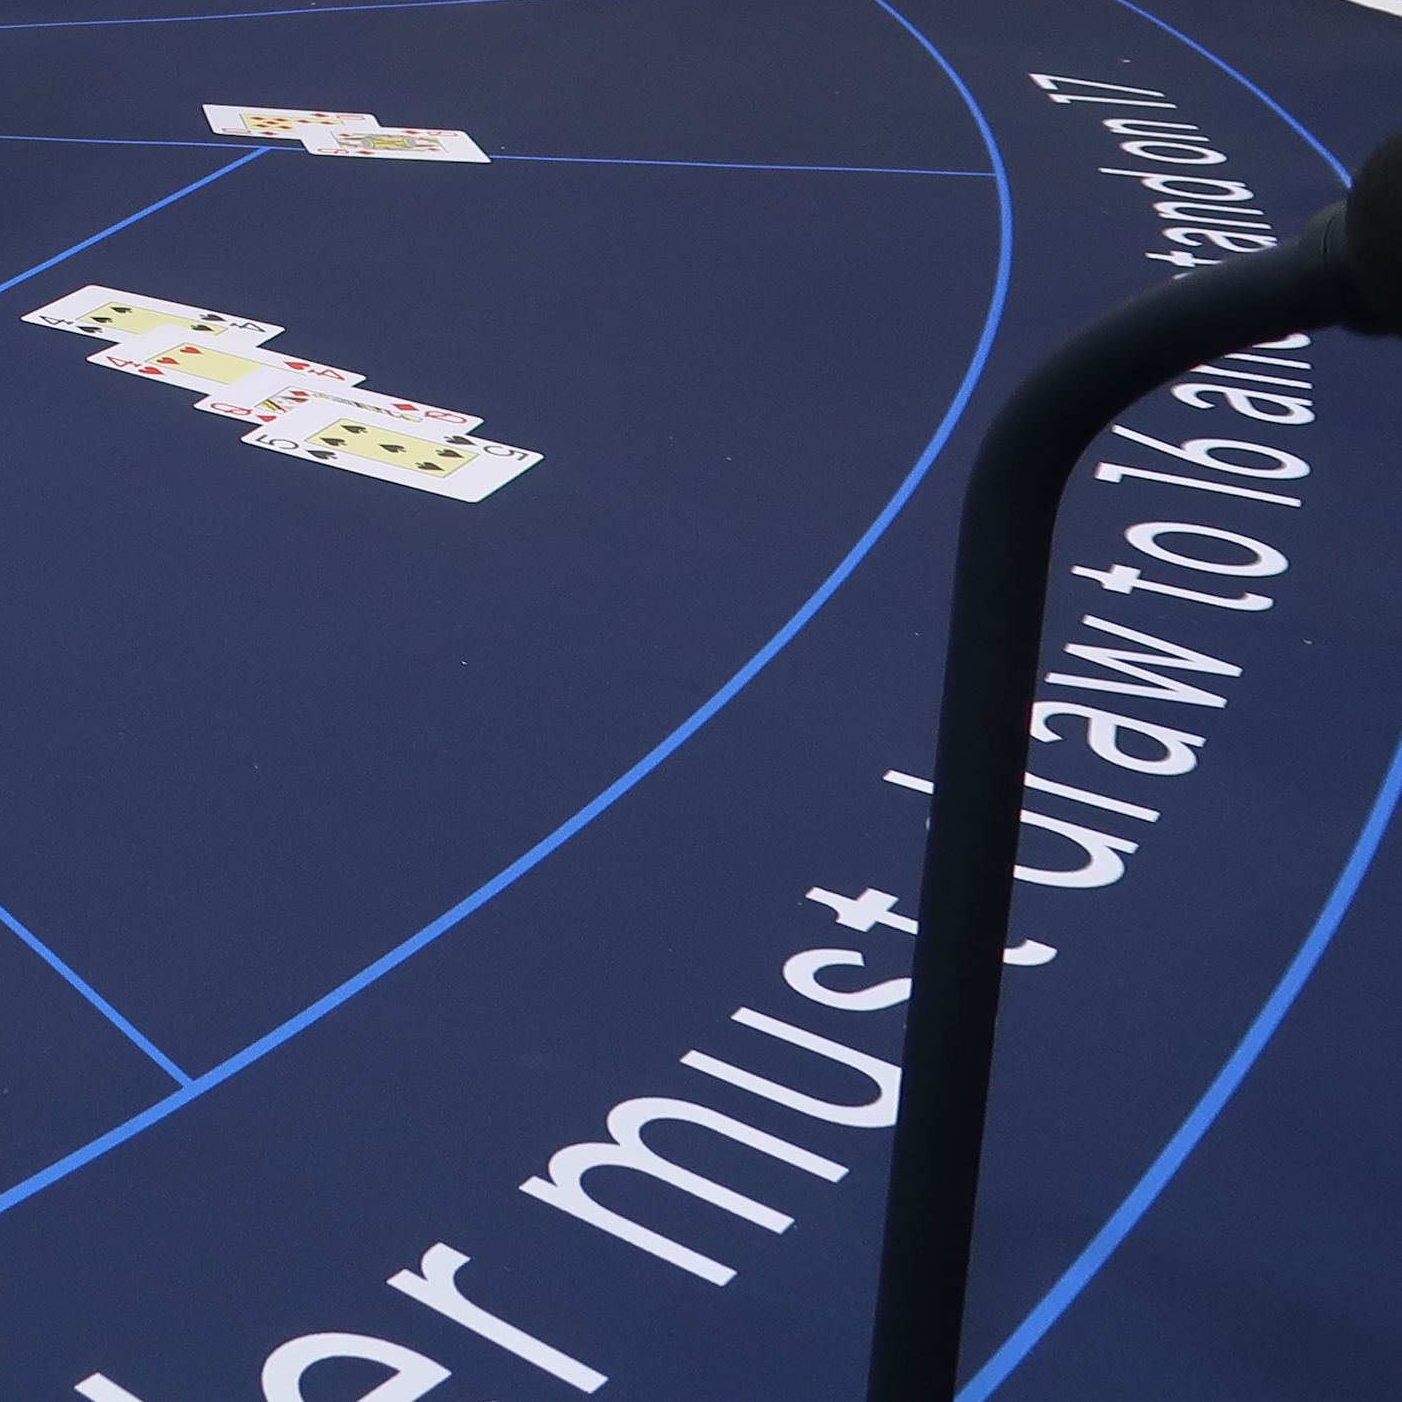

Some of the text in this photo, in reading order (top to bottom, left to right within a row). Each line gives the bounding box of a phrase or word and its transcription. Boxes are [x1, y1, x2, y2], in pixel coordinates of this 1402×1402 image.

[1028, 71, 1179, 109] 17
[1101, 117, 1229, 165] on
[1097, 166, 1281, 280] tand
[39, 315, 74, 326] 4
[230, 322, 266, 333] 4
[106, 355, 142, 368] 4
[307, 367, 346, 381] 4
[1171, 332, 1316, 426] an
[210, 402, 252, 416] Q
[424, 410, 467, 425] Q
[255, 434, 299, 451] 5
[482, 445, 529, 462] 5
[1095, 423, 1312, 508] 16
[1070, 521, 1289, 612] to
